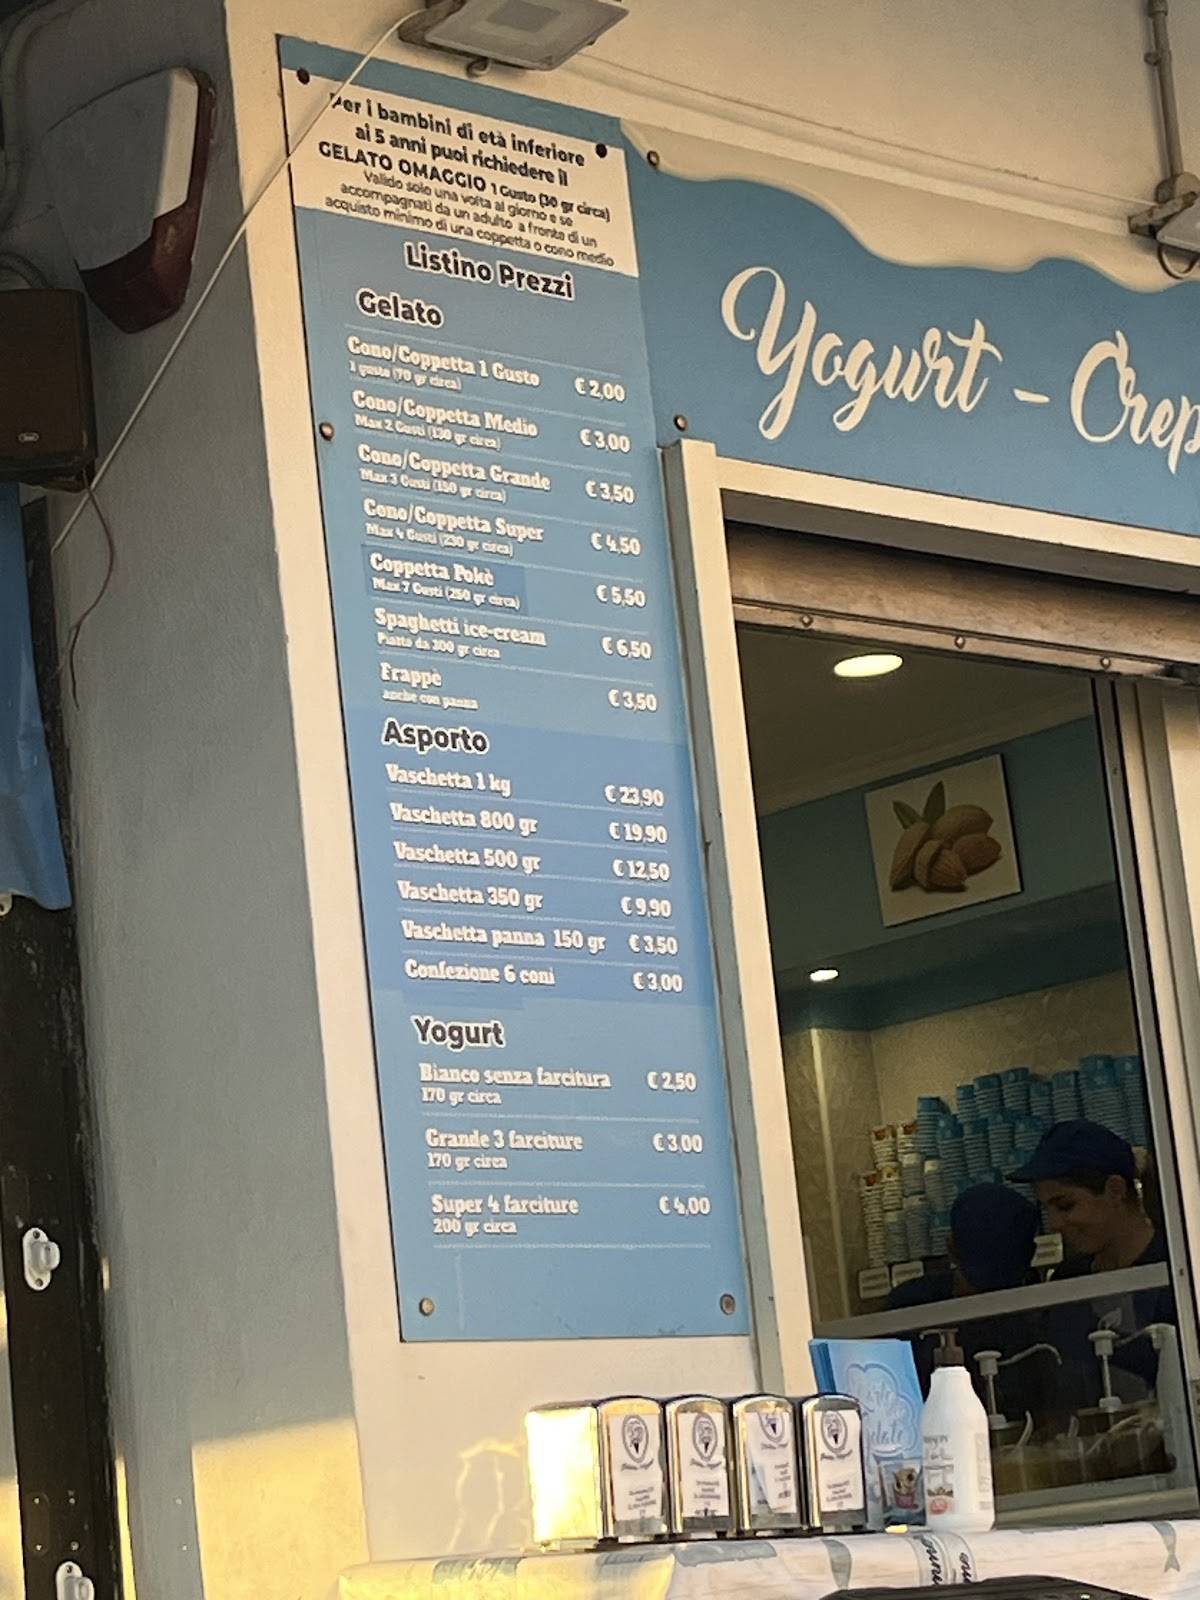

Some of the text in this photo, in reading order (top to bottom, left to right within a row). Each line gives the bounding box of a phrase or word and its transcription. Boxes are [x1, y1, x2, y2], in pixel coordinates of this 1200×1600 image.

[366, 99, 585, 167] i bambini di età inferiore
[355, 122, 568, 186] ai 5 anni puoi richiedere il
[318, 141, 393, 171] GELATO
[398, 158, 486, 191] OMAGGIO
[490, 182, 498, 195] 1
[500, 185, 537, 204] Gusto
[576, 202, 611, 223] circa)
[363, 170, 573, 227] Valido solo una volta al giorno se
[325, 196, 615, 267] acquisto minimo di una coppetta o cono medio
[340, 184, 598, 248] accompagnati da un adulto di un
[405, 241, 575, 300] Listino Prezzi
[357, 289, 443, 327] Gelato
[347, 336, 626, 402] Cono/Coppetta 1 Gusto € 2,00
[720, 266, 1003, 440] Yogurt
[429, 375, 462, 391] circa)
[352, 389, 631, 453] Cono/Coppetta Medio € 3,00
[354, 413, 501, 452] Max 2 Gusti circa)
[357, 443, 635, 504] Cono/Coppetta Grande € 3,50
[359, 467, 507, 503] Max Gusti circa)
[363, 498, 641, 556] Cono/Coppetta Super € 4,50
[365, 522, 514, 558] Max 4 Gusti circa)
[370, 552, 646, 608] Coppetta € 5,50
[372, 576, 521, 611] Max 7 Gusti circa)
[374, 607, 652, 659] Spaghetti ice-cream € 6,50
[377, 631, 413, 648] Piatto
[414, 637, 431, 650] da
[457, 644, 471, 658] gr
[471, 645, 501, 659] circa
[380, 661, 657, 712] Frappè € 3,50
[382, 719, 489, 753] Asporto
[386, 762, 664, 807] Vaschetta 1 kg € 23,90
[390, 801, 668, 844] Vaschetta 800 gr € 19,90
[393, 841, 671, 881] Vaschetta 500 gr € 12,50
[397, 879, 672, 918] Vaschetta 350 gr € 9,90
[400, 919, 678, 956] Vaschetta panna 150 gr € 3,50
[405, 958, 683, 993] Confezione 6 coni € 3,00
[411, 1015, 506, 1051] Yogurt
[419, 1062, 696, 1092] Bianco senza farcitura € 2,50
[421, 1087, 502, 1106] 170 gr circa
[425, 1128, 703, 1154] Grande 3 farciture € 3,00
[427, 1152, 508, 1171] 170 gr circa
[431, 1194, 711, 1217] Super 4 farciture € 4,00
[433, 1218, 518, 1237] 200 gr circa
